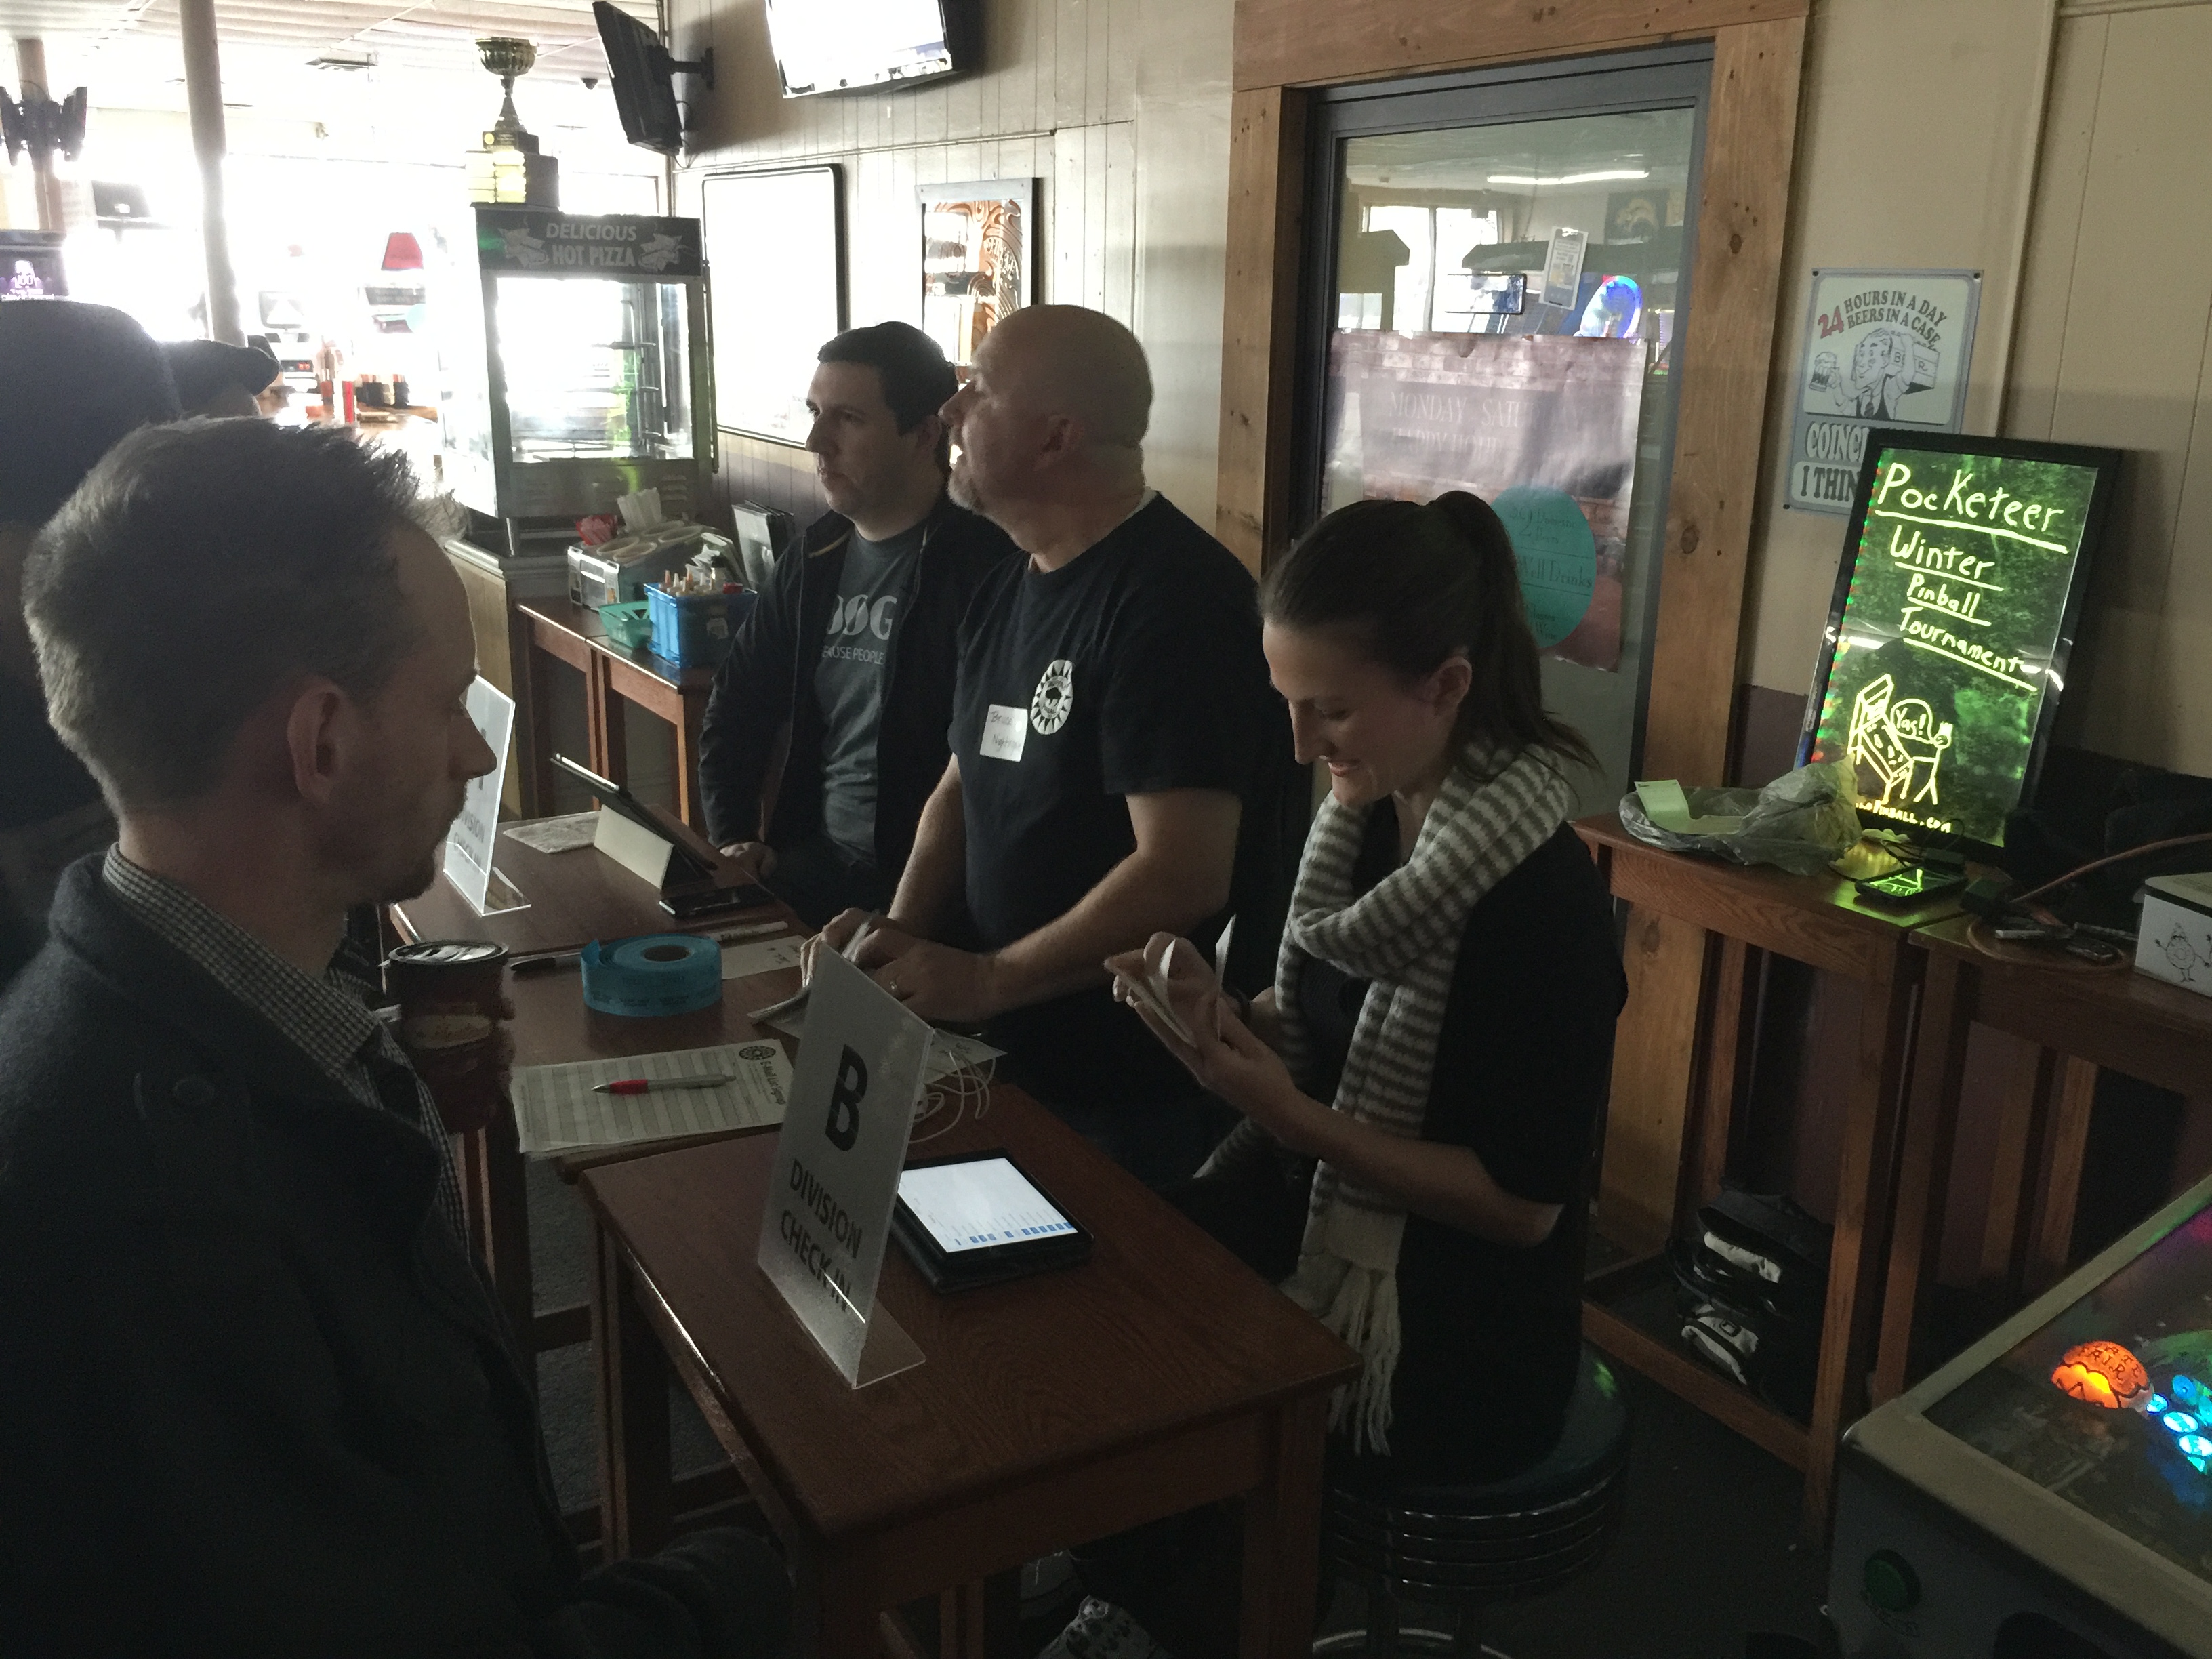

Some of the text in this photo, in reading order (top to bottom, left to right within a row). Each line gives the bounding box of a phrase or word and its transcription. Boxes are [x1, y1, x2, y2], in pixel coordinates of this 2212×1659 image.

[546, 223, 637, 241] DELICIOUS
[552, 245, 636, 267] HOT PIZZA
[1818, 306, 1844, 339] 24
[1844, 291, 1947, 327] HOURS IN A DAY
[1847, 308, 1941, 346] BEERS IN A CASE
[1894, 351, 1928, 372] BR
[1389, 391, 1467, 424] MONDAY
[1805, 421, 1870, 462] COINCI
[1801, 465, 1861, 502] I THIN
[1890, 525, 1995, 579] Winter
[1549, 560, 1592, 588] Drinks
[1907, 573, 1980, 617] Pinball
[853, 647, 885, 665] PEOPLE
[1900, 607, 2024, 672] Tournament
[461, 811, 485, 844] VISION
[825, 1043, 868, 1152] B
[790, 1158, 863, 1259] DIVISION
[781, 1210, 852, 1312] CHECK IN
